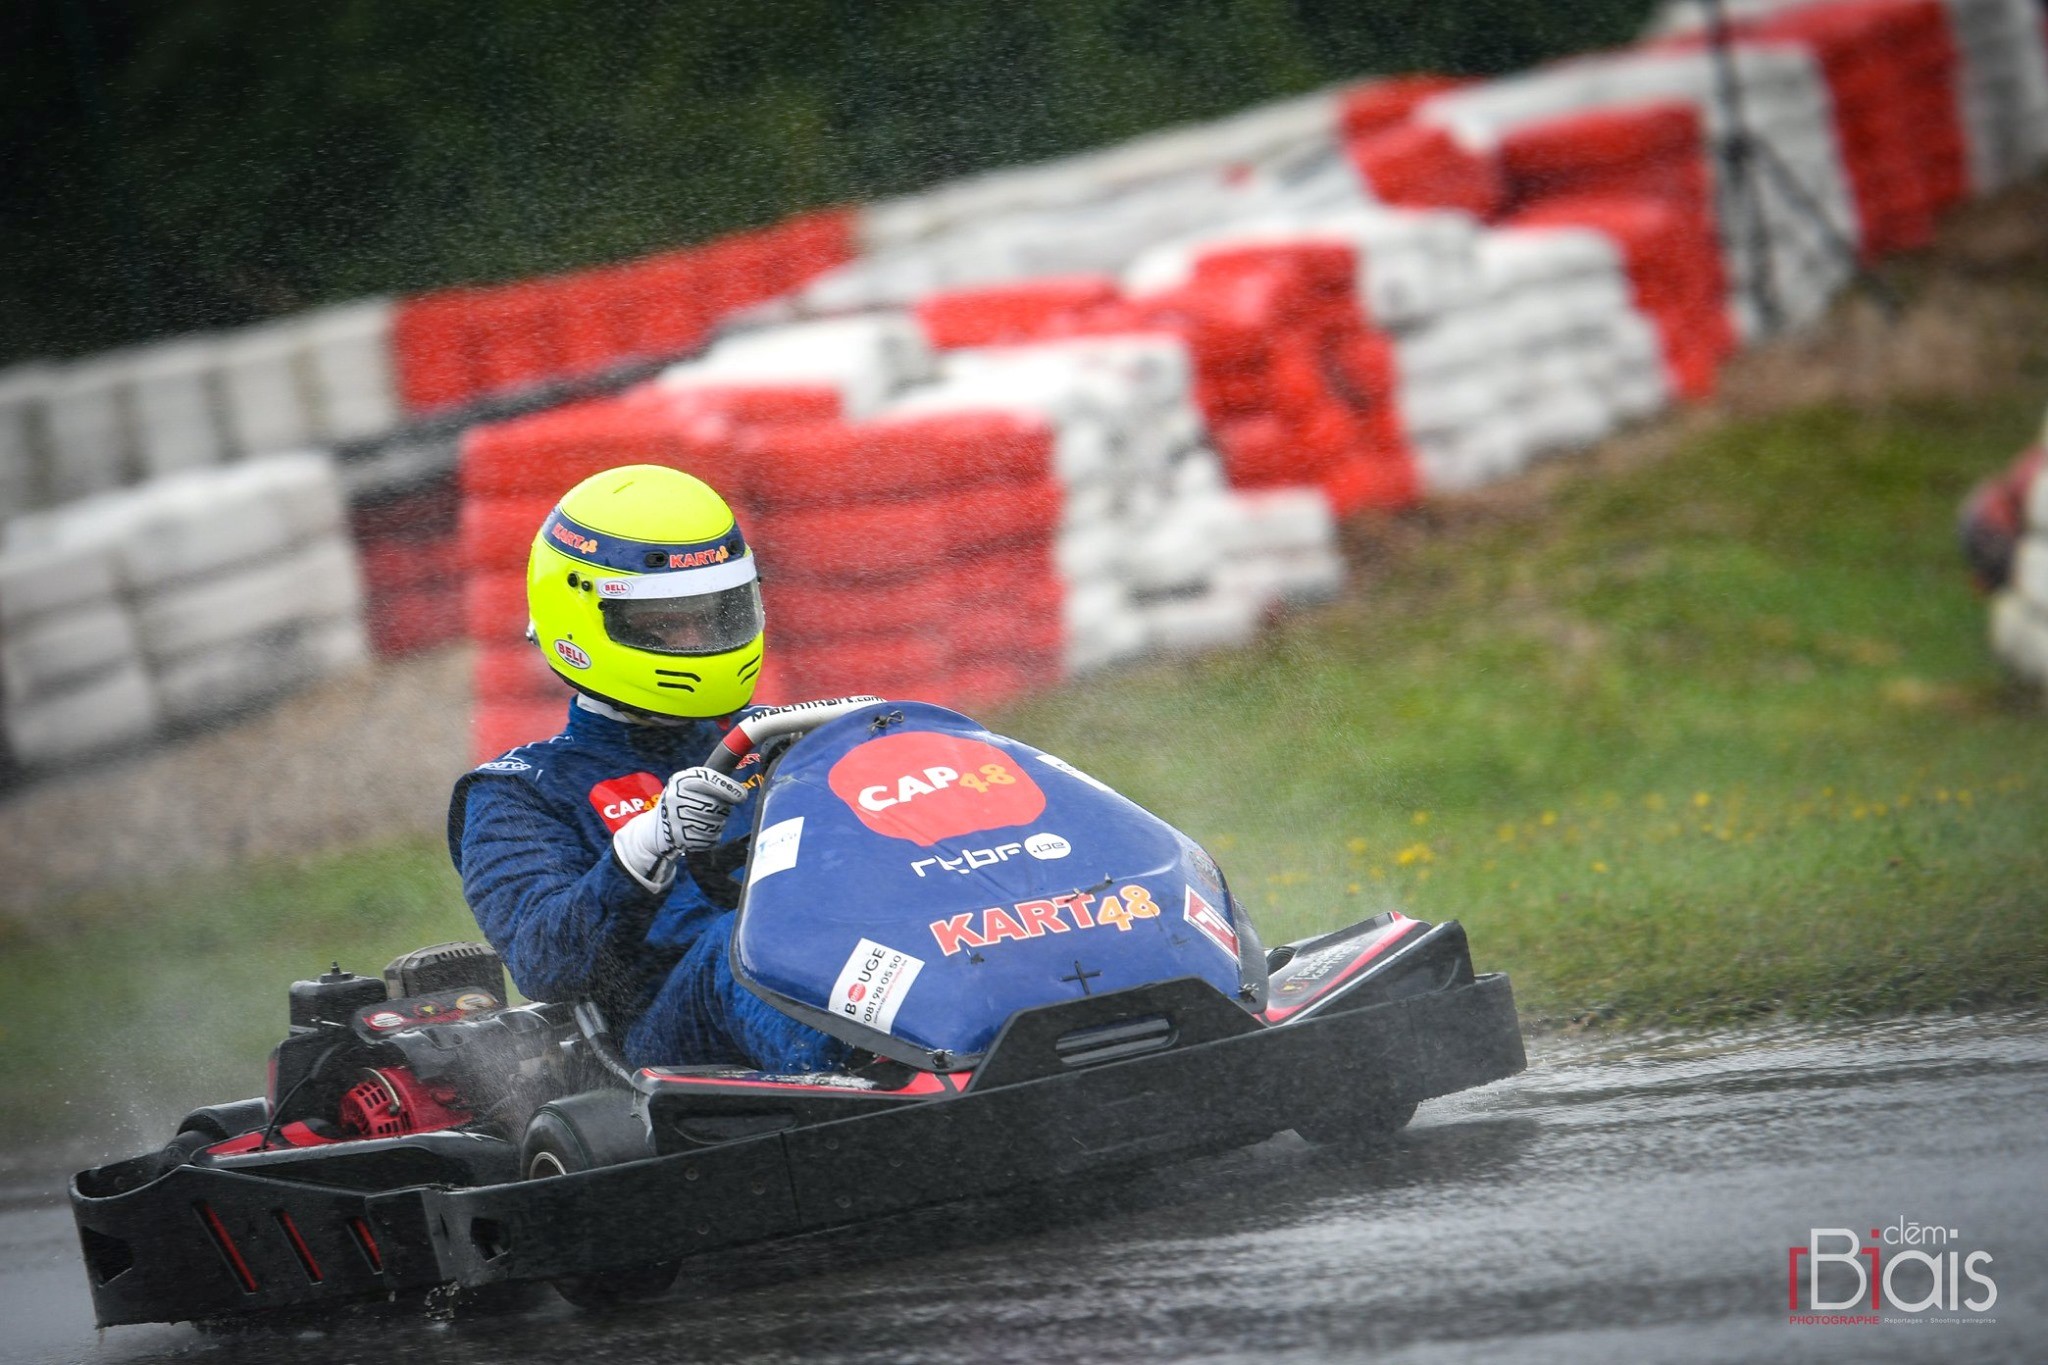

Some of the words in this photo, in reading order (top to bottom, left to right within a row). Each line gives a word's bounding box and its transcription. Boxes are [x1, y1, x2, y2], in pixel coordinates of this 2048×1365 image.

[552, 523, 597, 554] KART48
[670, 545, 729, 568] KART48
[558, 642, 588, 665] BELL
[710, 774, 742, 798] freem
[858, 764, 1016, 811] CAP48
[929, 884, 1160, 956] KART48
